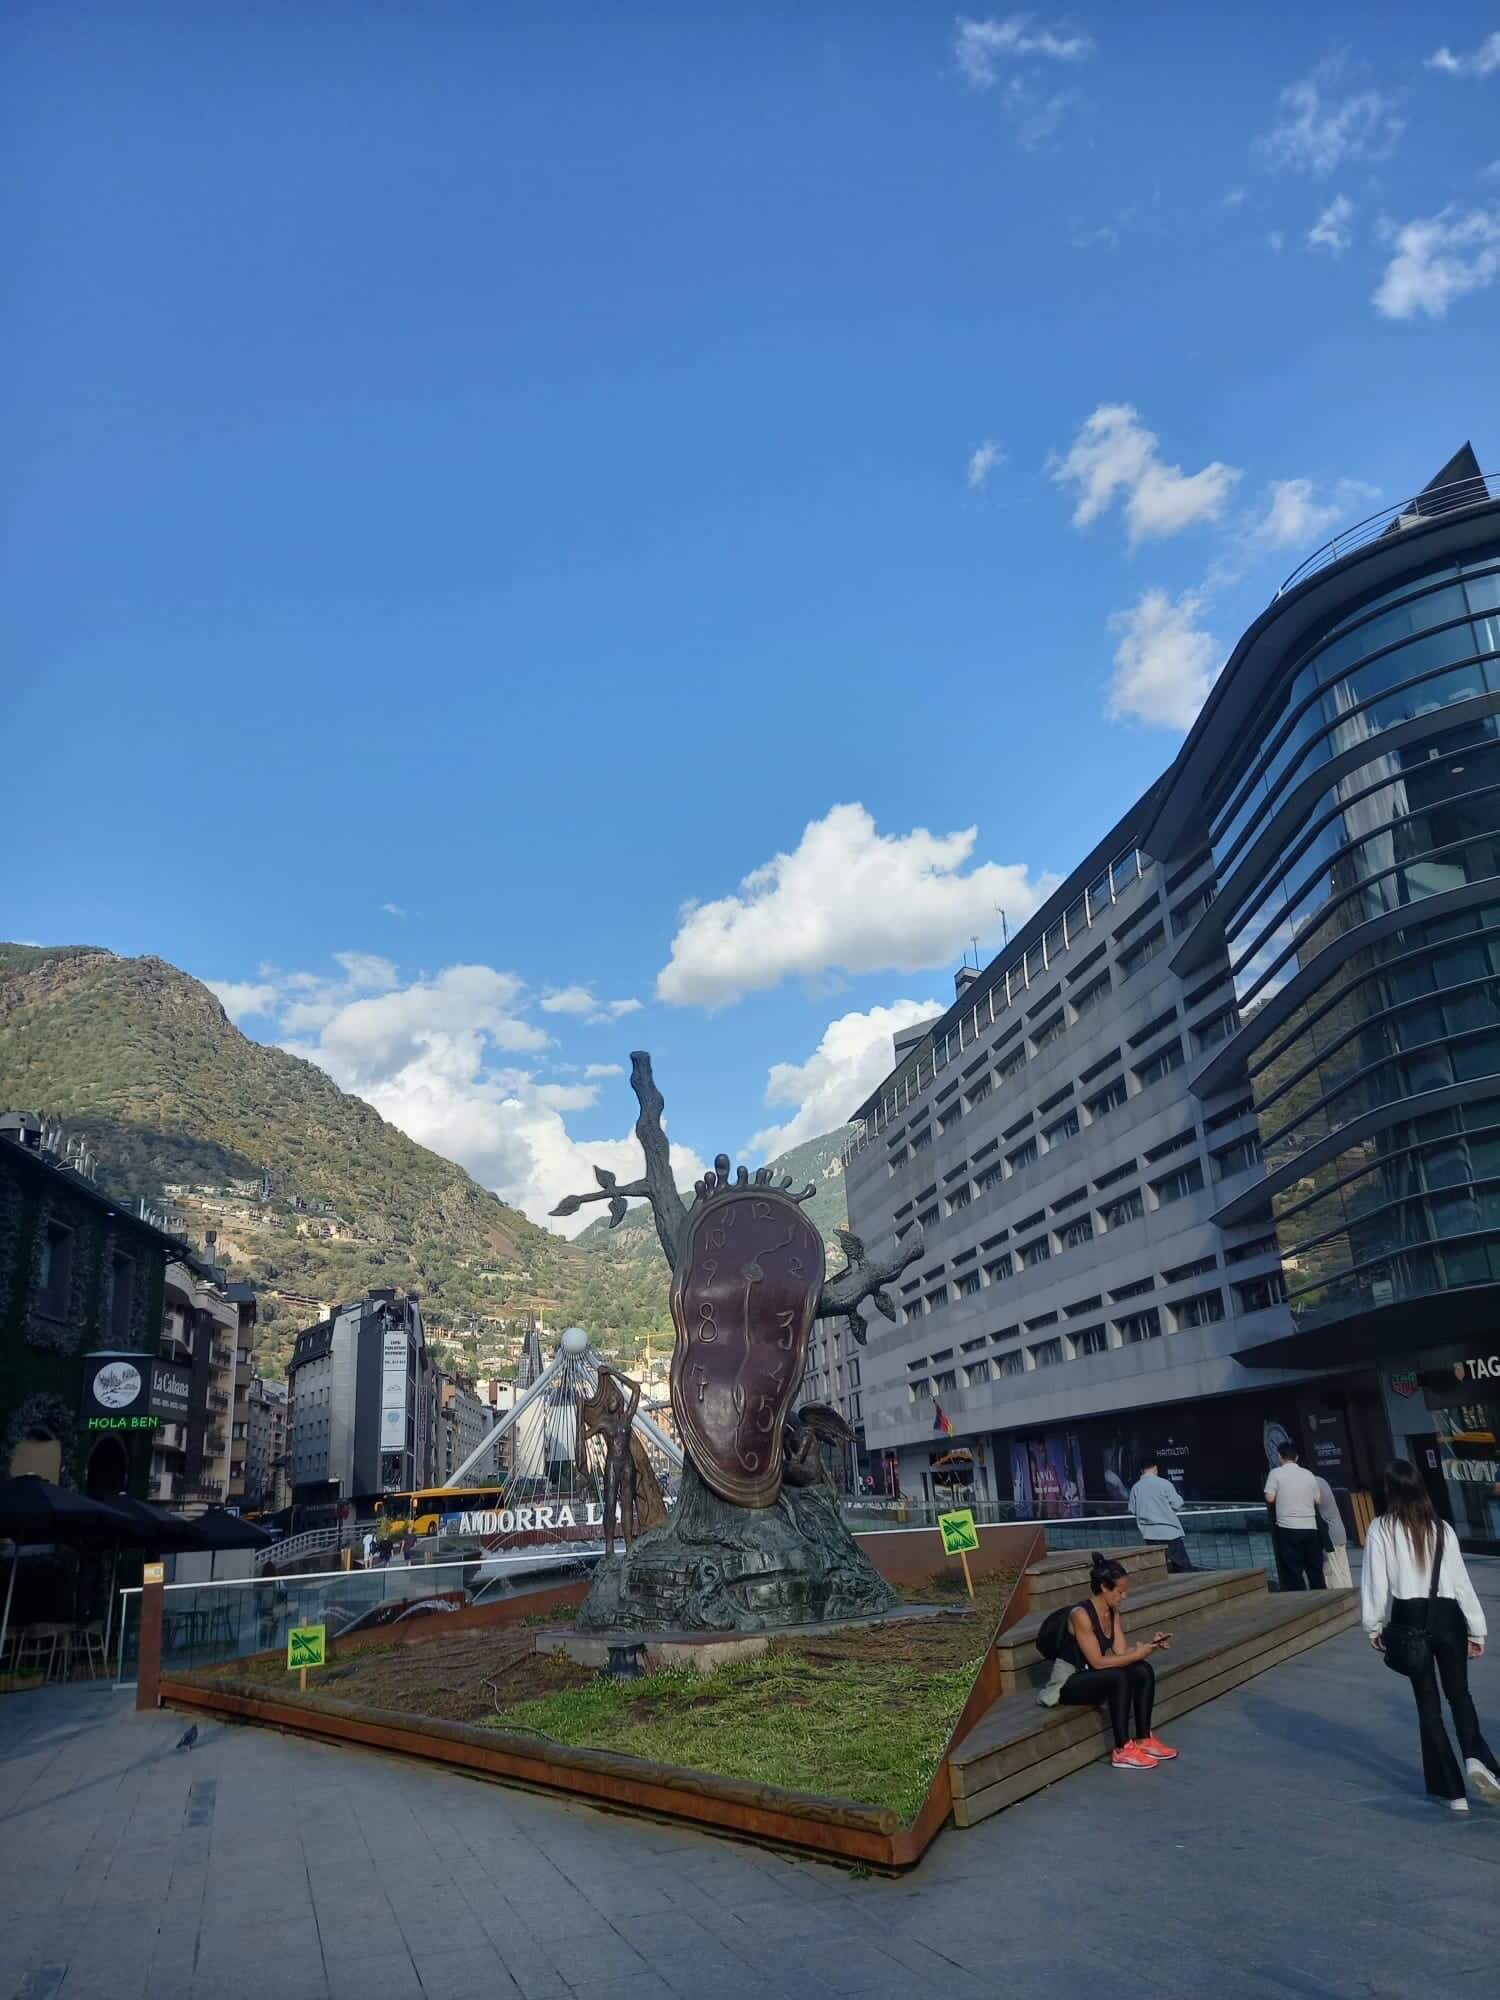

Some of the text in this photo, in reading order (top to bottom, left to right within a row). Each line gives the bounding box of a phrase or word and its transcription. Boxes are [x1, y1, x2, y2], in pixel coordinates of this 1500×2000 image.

[751, 1201, 777, 1222] 12
[789, 1256, 805, 1280] 2
[698, 1302, 719, 1343] 8
[775, 1309, 795, 1350] 3
[1465, 1355, 1500, 1380] TAG
[153, 1370, 189, 1398] La Cabana
[88, 1416, 159, 1430] HOLA BEN
[756, 1394, 774, 1433] 5
[458, 1504, 577, 1537] ANDORRA
